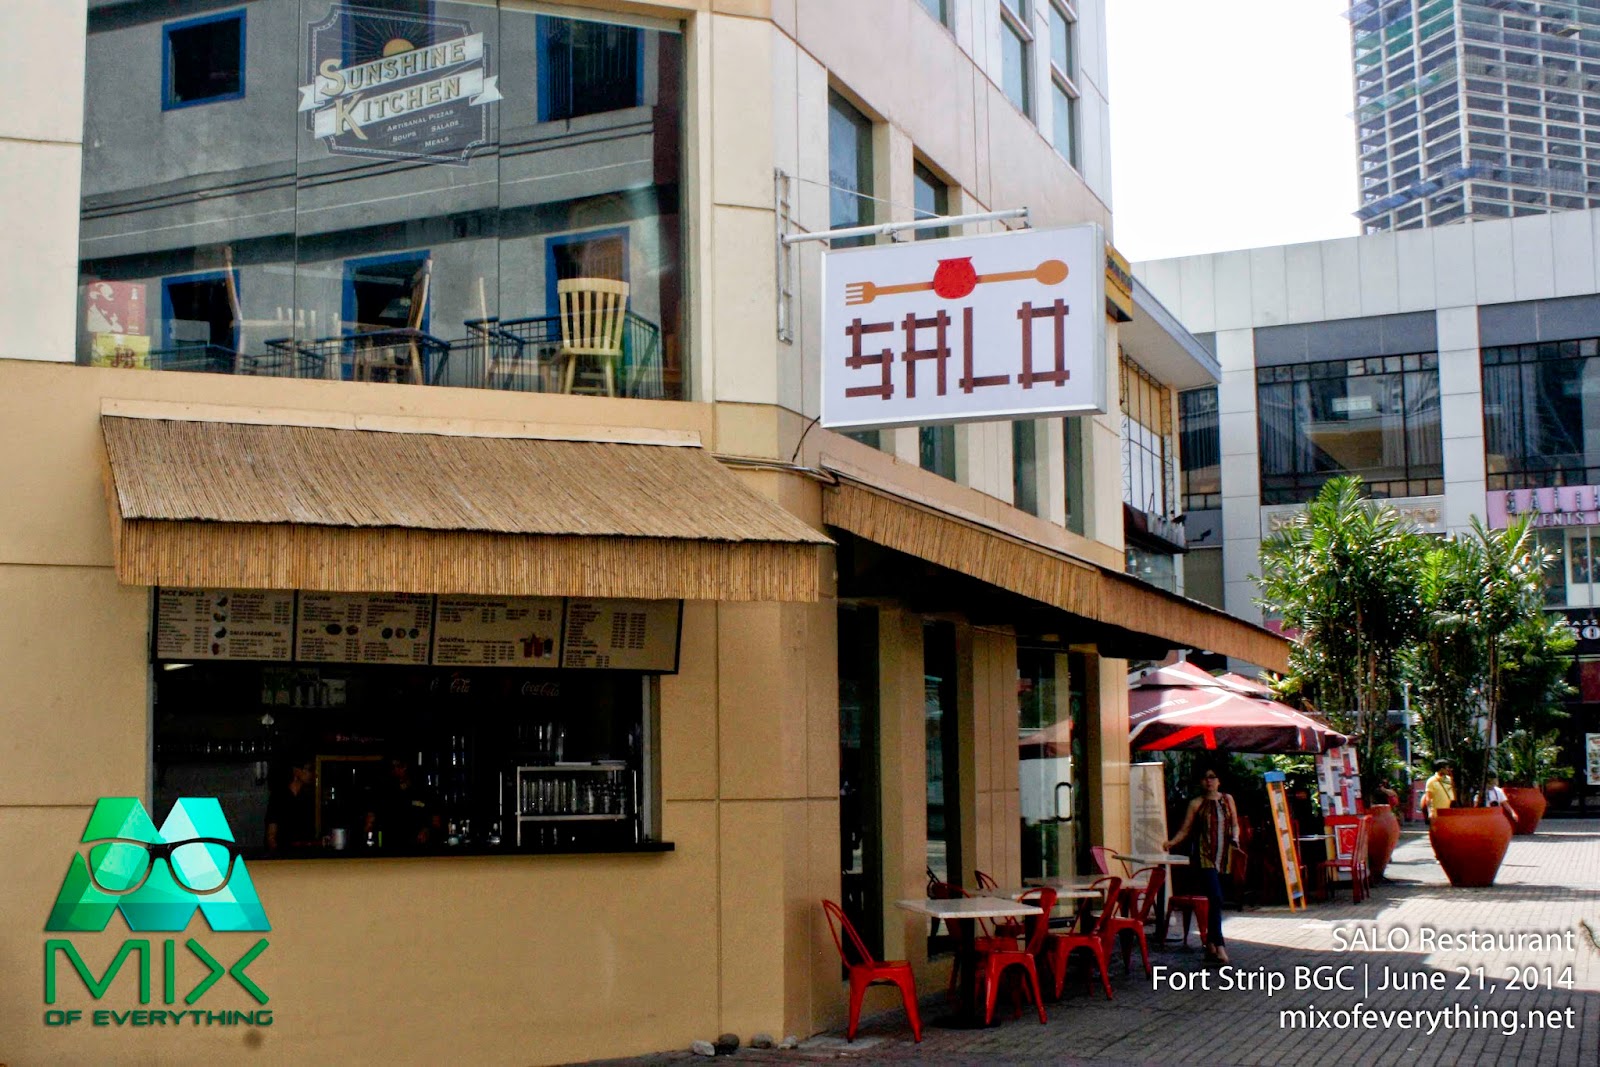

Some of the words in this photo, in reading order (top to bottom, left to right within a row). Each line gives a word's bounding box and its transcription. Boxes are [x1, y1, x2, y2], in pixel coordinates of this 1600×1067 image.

[319, 39, 467, 97] SUNSHINE
[334, 76, 461, 141] KITCHEN
[386, 117, 427, 133] ARTISANAL
[428, 109, 455, 121] PIZZAS
[392, 131, 417, 143] SOUPS
[430, 119, 460, 133] SALADS
[424, 136, 450, 148] MEALS
[845, 298, 1071, 401] SALO
